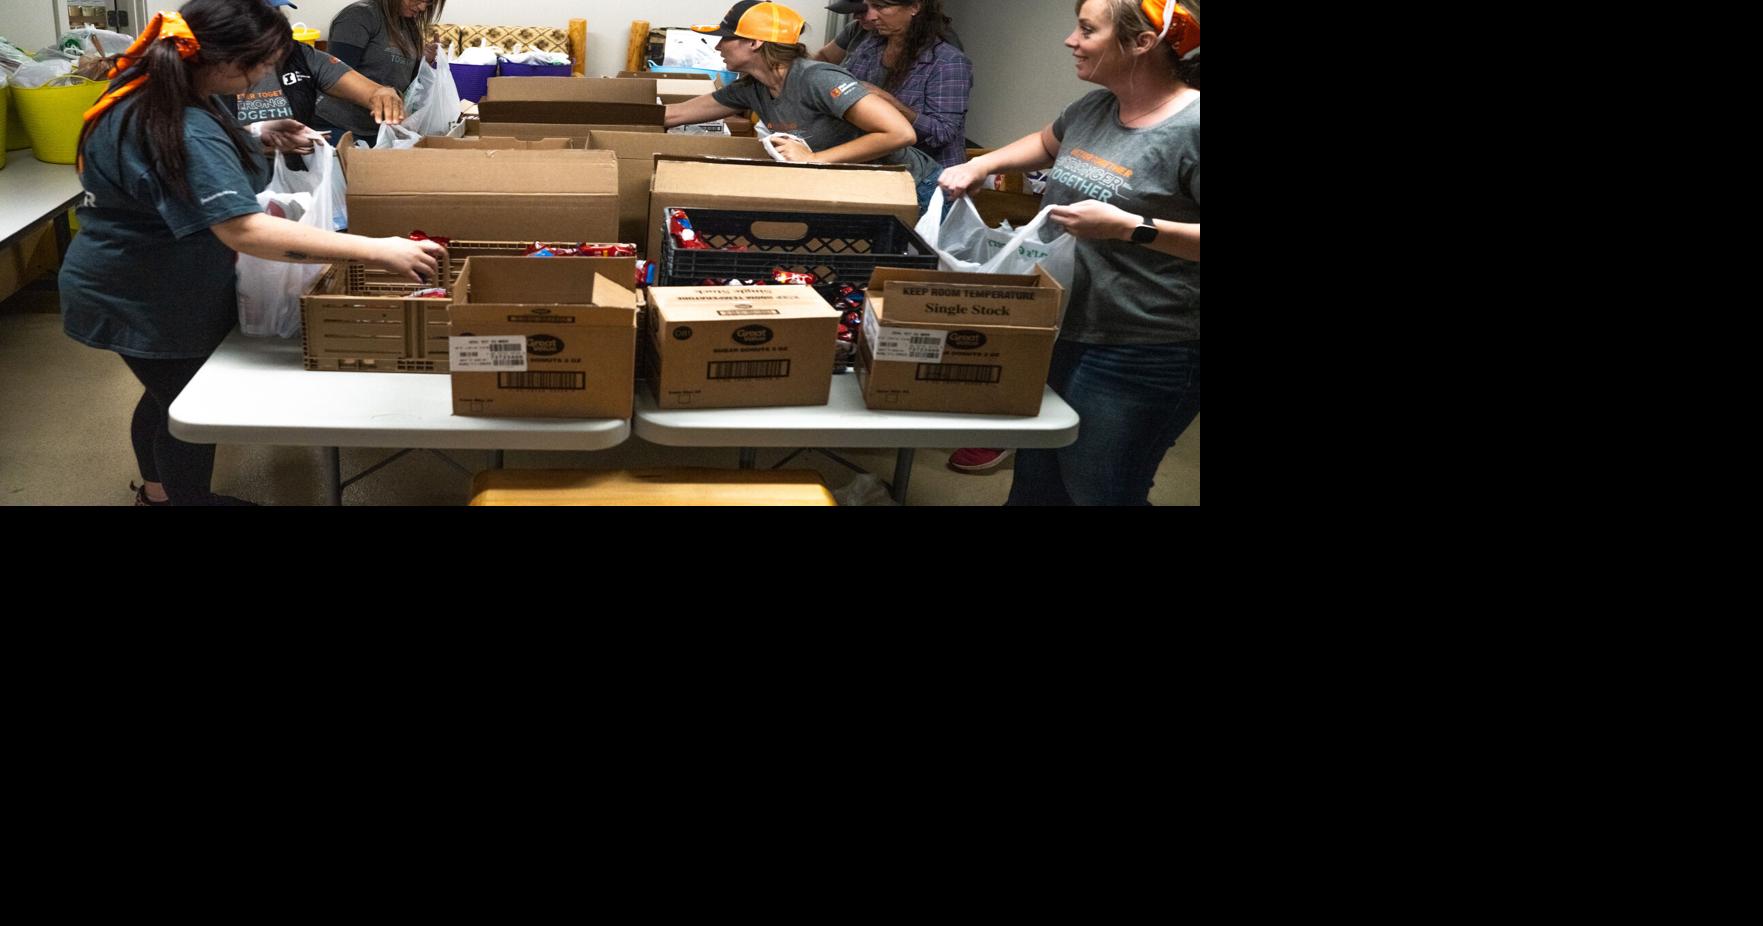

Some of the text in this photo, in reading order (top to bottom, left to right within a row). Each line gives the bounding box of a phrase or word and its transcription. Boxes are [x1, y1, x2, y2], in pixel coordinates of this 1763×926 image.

[237, 106, 294, 121] OGETH
[903, 287, 1036, 300] KEEP ROOM TEMPERATURE
[925, 302, 1010, 316] Single Stock
[736, 328, 767, 338] Great
[948, 333, 979, 342] Great
